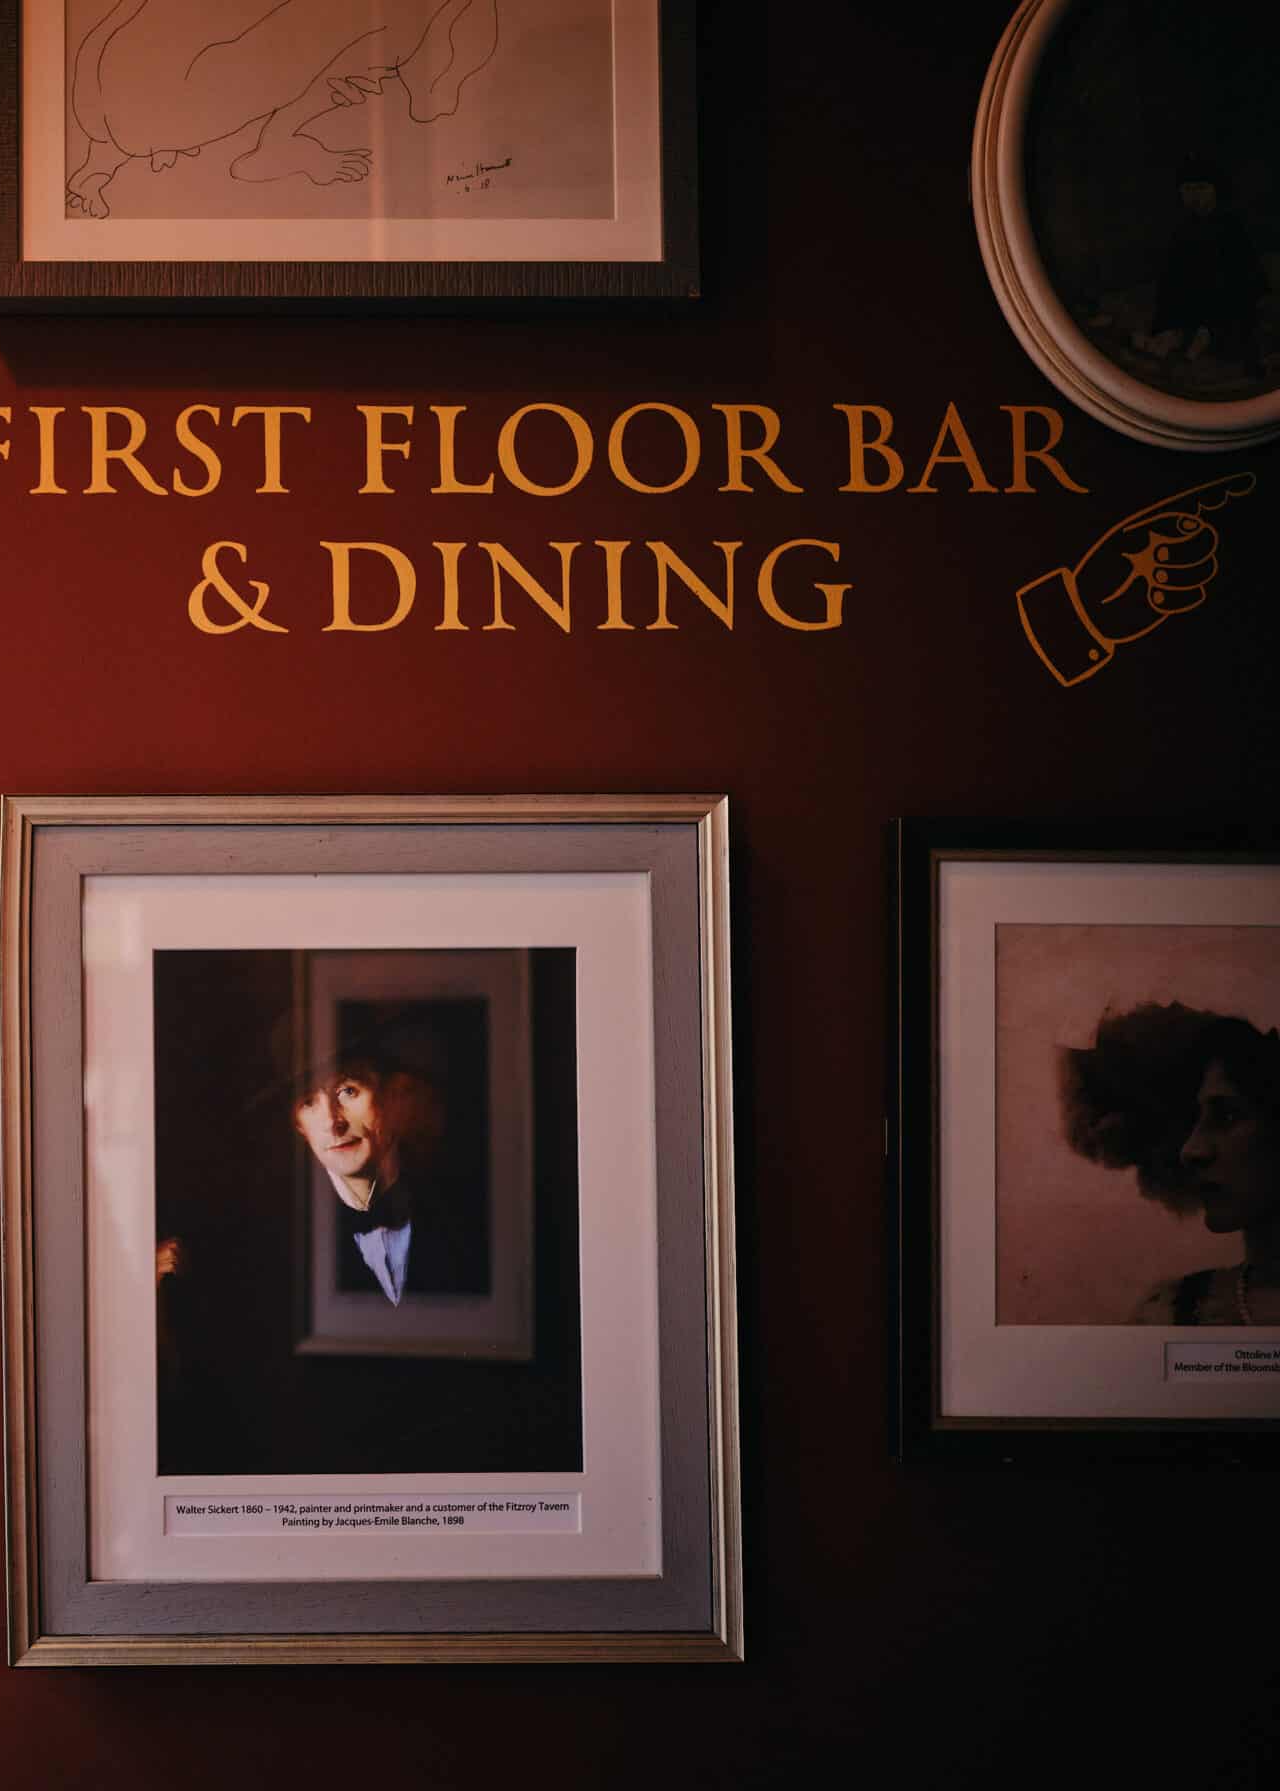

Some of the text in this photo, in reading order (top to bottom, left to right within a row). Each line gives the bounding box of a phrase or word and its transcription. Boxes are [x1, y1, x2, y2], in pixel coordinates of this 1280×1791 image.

[357, 402, 804, 497] FLOOR
[832, 401, 1089, 493] BAR
[188, 538, 852, 635] & DINING
[1174, 1361, 1212, 1372] Member
[1214, 1361, 1225, 1372] of
[1226, 1361, 1240, 1372] the
[176, 1504, 206, 1514] Walter
[207, 1504, 239, 1514] Sickert
[241, 1504, 263, 1514] 1860
[273, 1504, 297, 1515] 1942,
[299, 1504, 332, 1515] painter
[334, 1503, 351, 1513] and
[353, 1503, 403, 1515] printmaker
[405, 1503, 423, 1512] and
[433, 1504, 475, 1512] customer
[477, 1502, 487, 1512] of
[489, 1502, 504, 1512] the
[506, 1502, 537, 1512] Fitzroy
[538, 1502, 570, 1512] Tavern
[281, 1516, 465, 1528] Painting by Jacques-Emile Blanche, 1898
